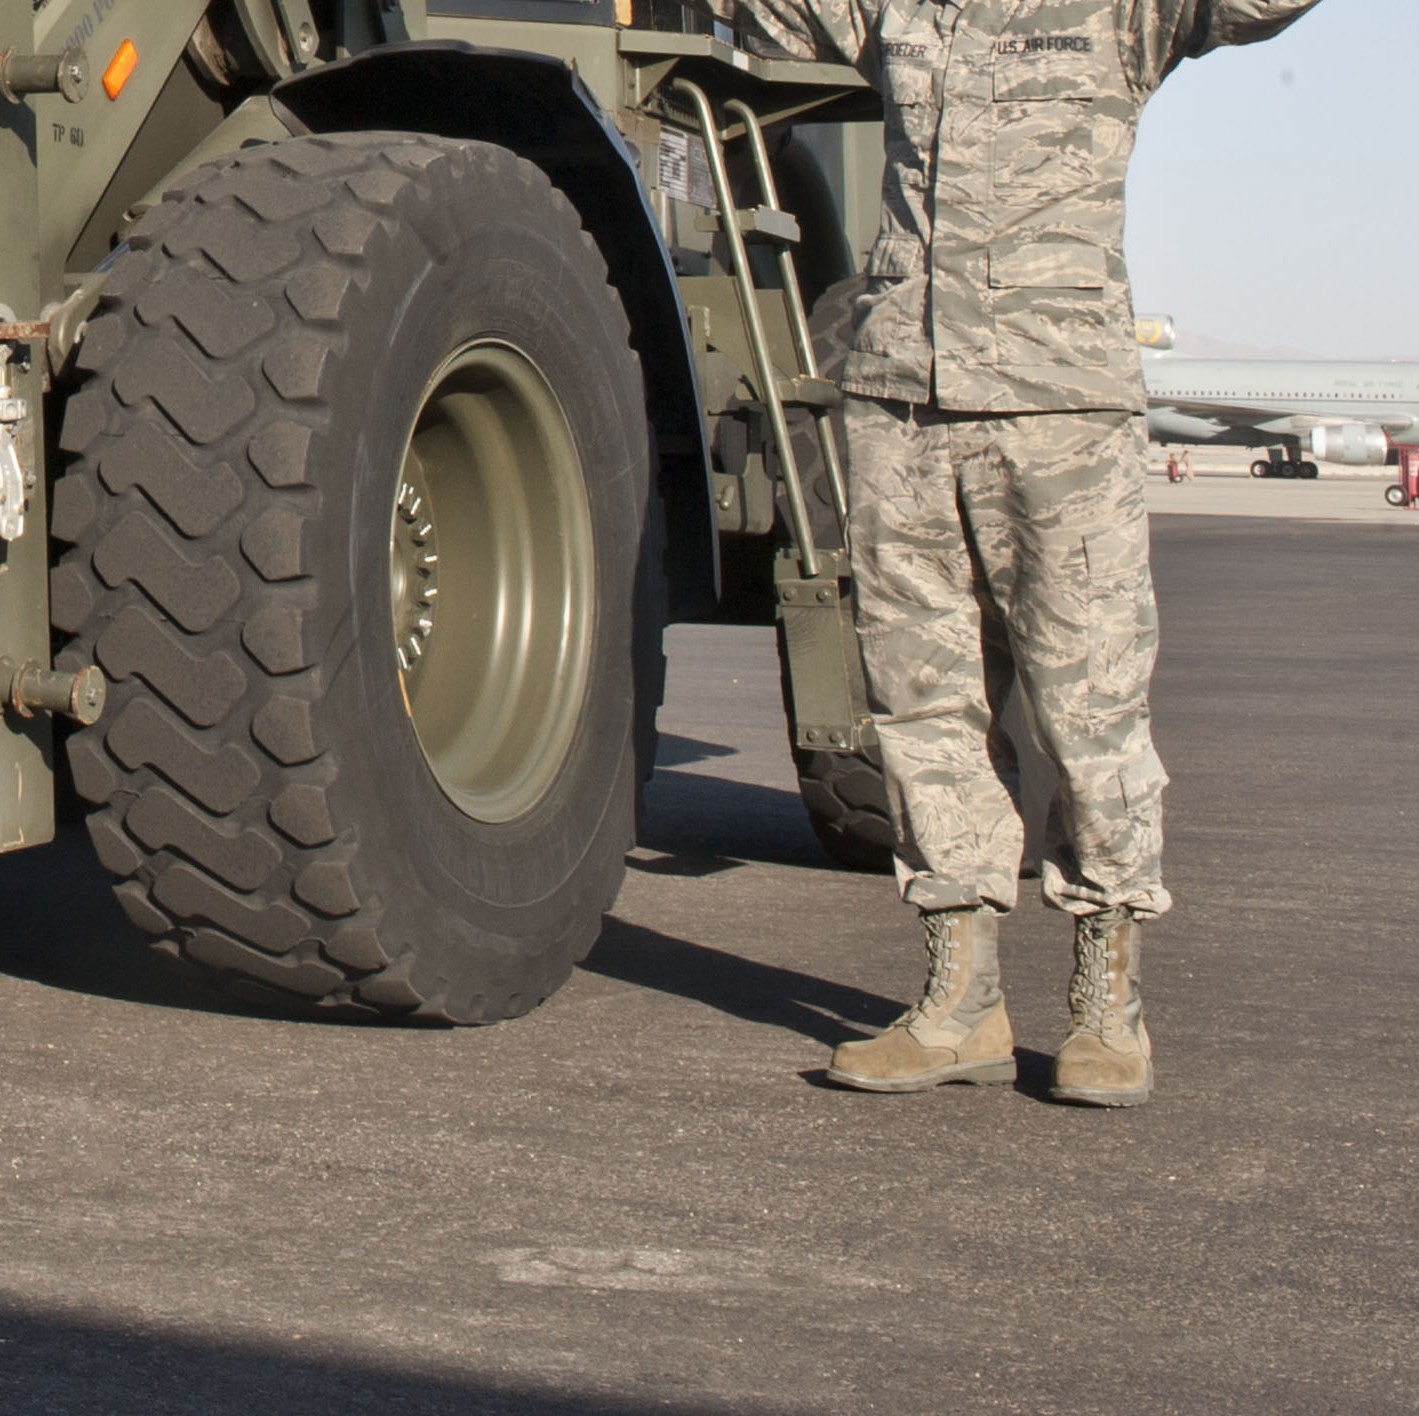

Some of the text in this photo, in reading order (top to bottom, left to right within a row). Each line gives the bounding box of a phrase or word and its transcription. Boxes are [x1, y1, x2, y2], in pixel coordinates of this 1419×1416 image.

[1023, 37, 1044, 52] AIR
[1046, 35, 1091, 52] FORCE
[70, 127, 84, 148] 60
